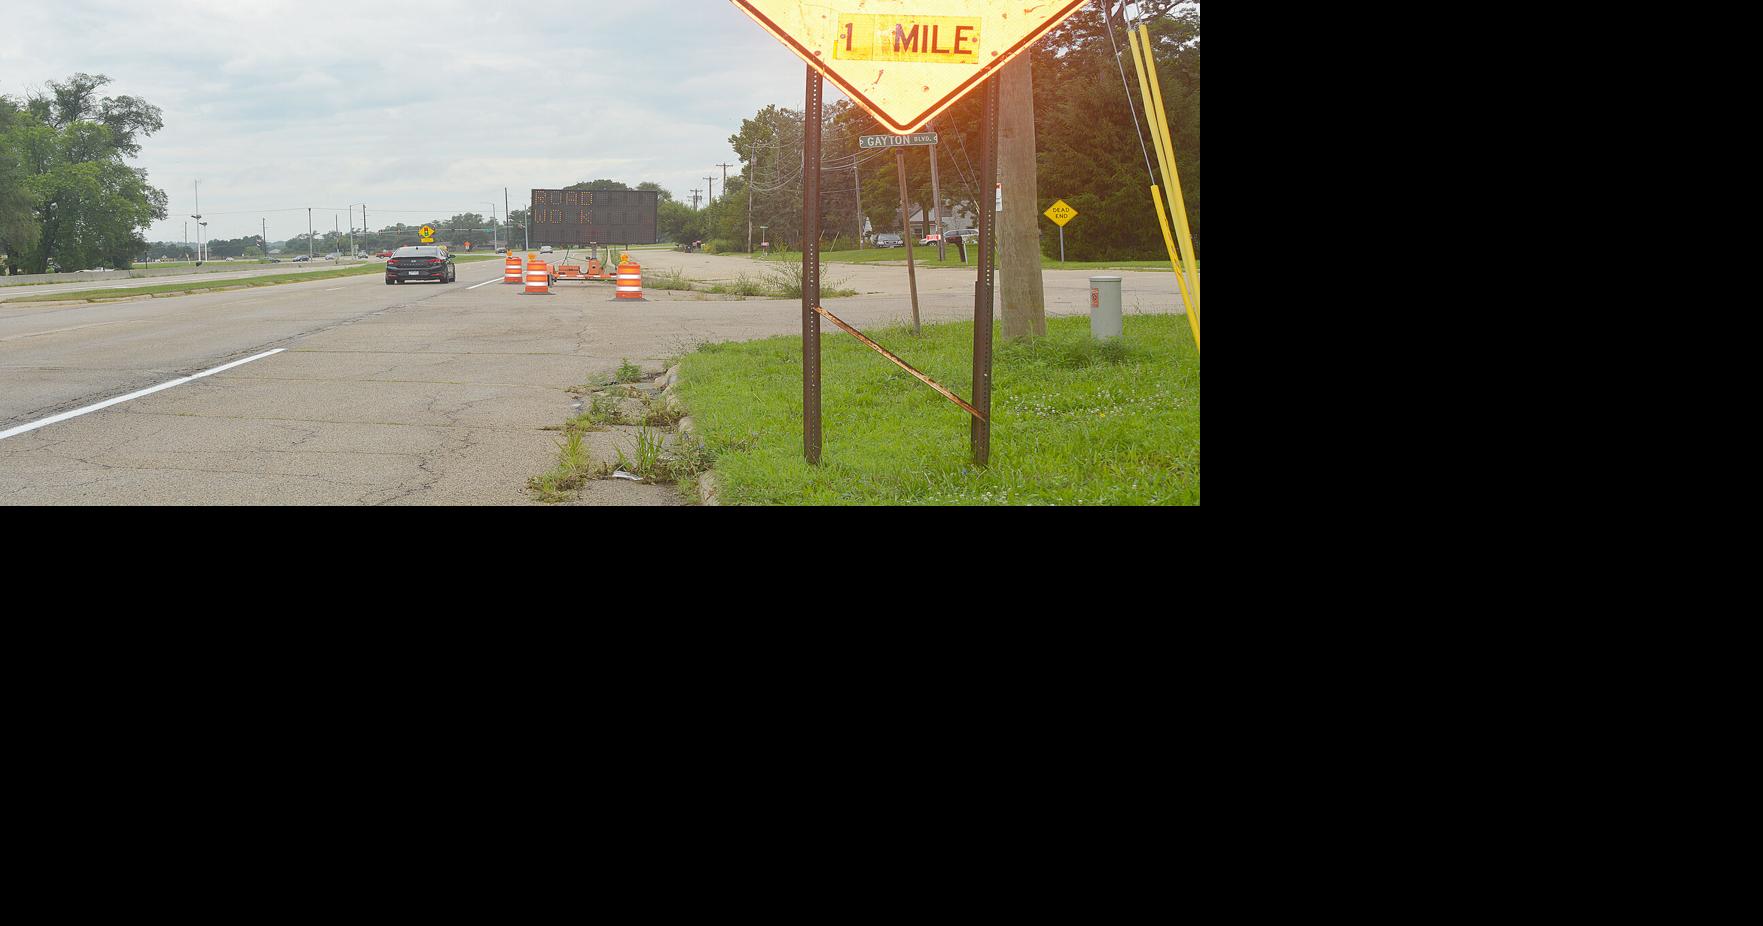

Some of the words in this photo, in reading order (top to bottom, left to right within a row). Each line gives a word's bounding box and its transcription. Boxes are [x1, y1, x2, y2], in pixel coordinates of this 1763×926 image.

[844, 22, 853, 52] 1
[893, 23, 974, 55] MILE
[867, 135, 910, 146] GAYTON
[534, 190, 593, 206] ROAD
